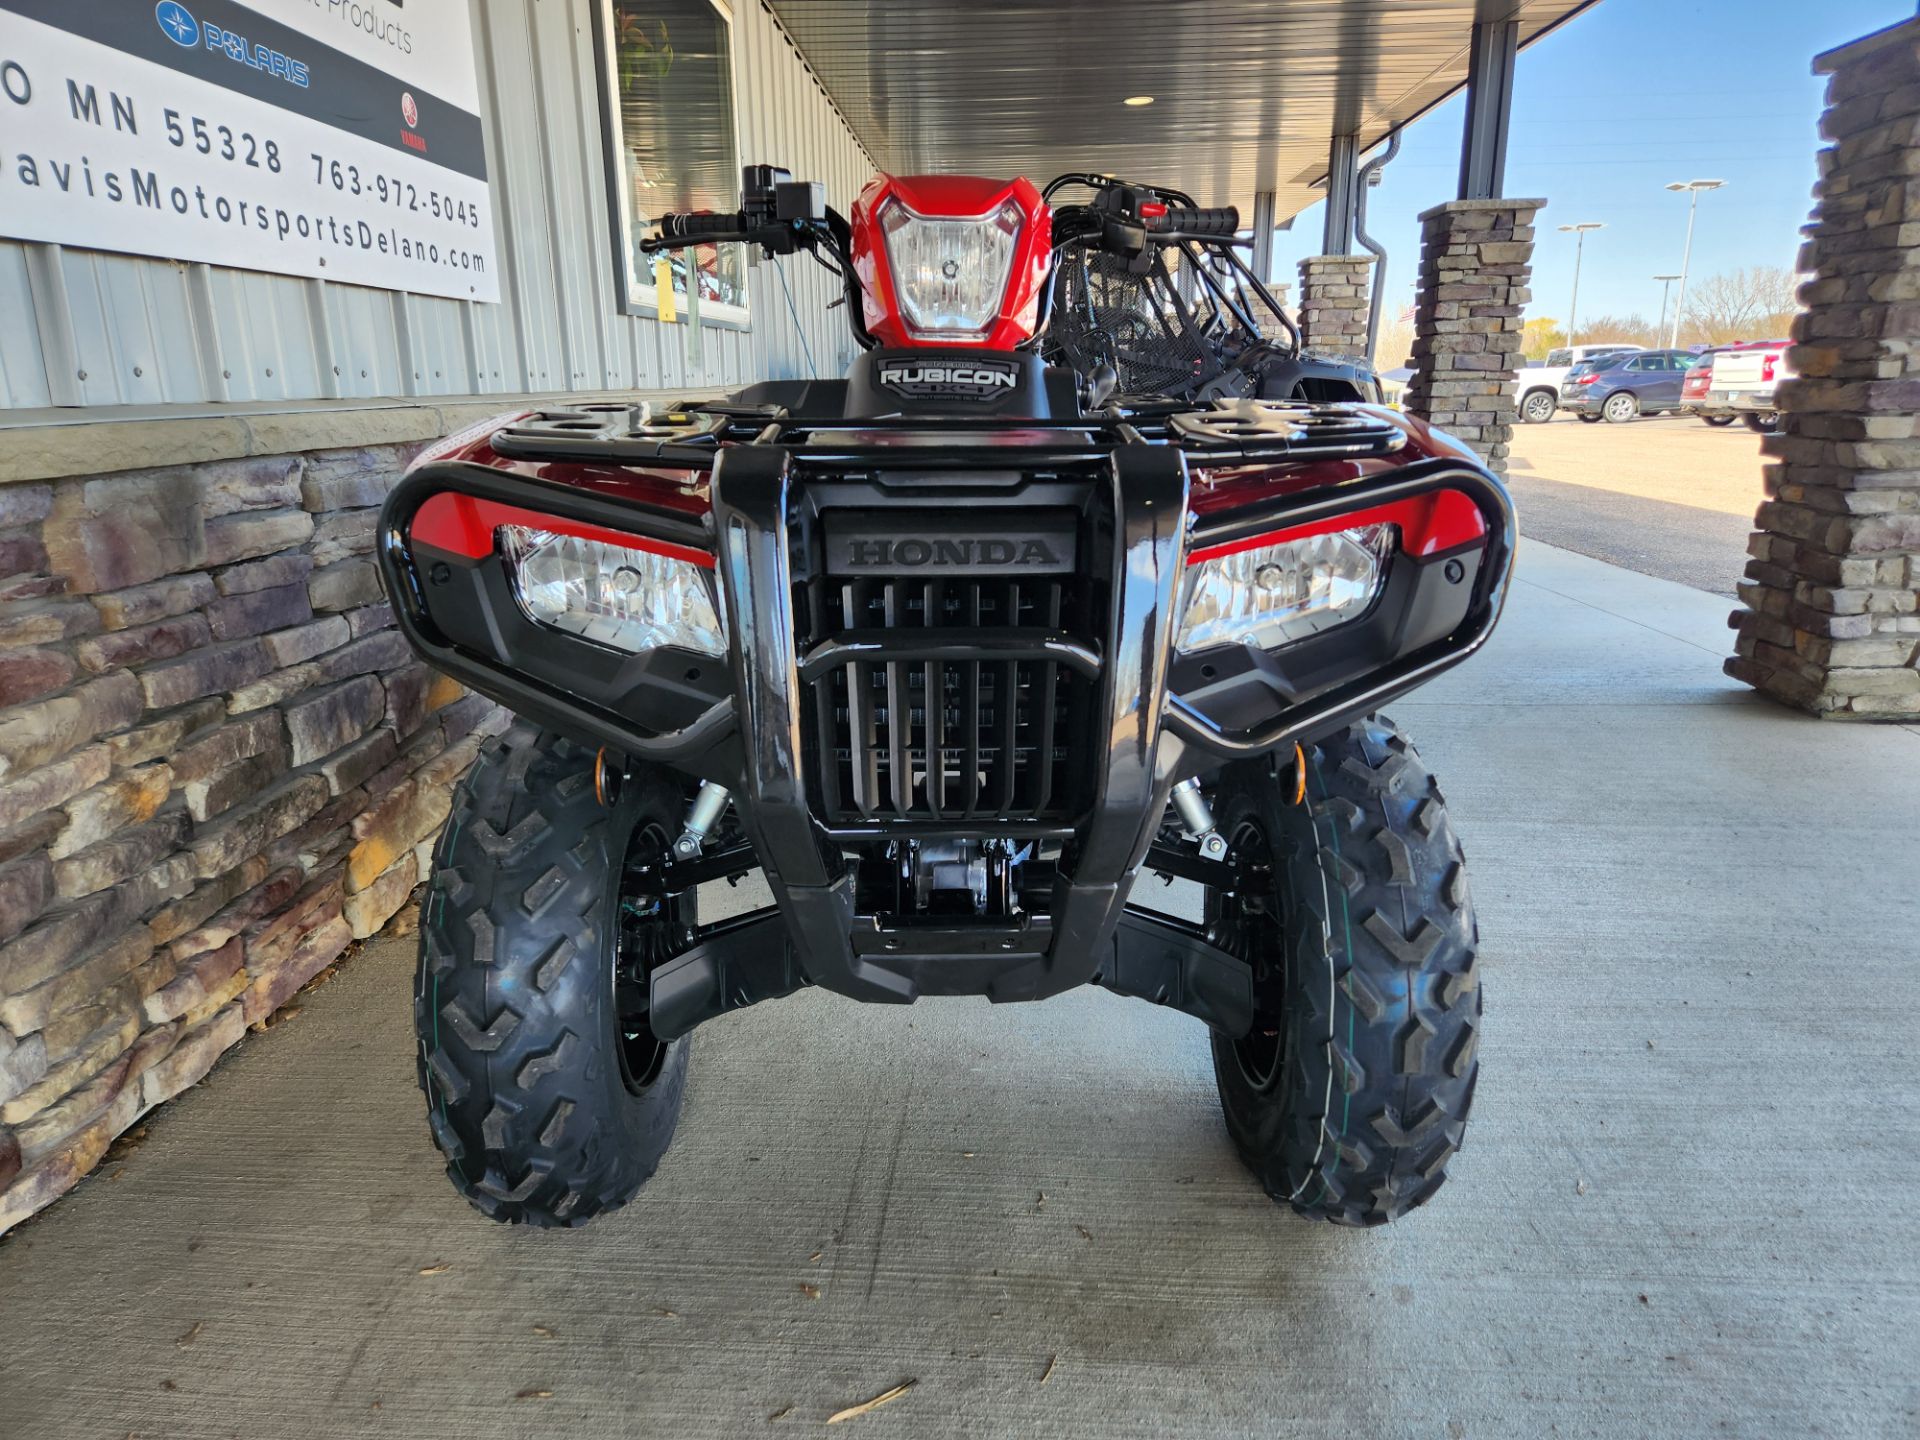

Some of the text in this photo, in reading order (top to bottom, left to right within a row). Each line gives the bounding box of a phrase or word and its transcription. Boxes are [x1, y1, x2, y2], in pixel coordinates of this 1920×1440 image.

[202, 20, 310, 88] POLARIS
[66, 77, 138, 136] MN
[163, 108, 281, 173] 55328
[311, 153, 478, 228] 763-972-5045
[0, 153, 485, 272] avisMotorsportsDelano.com
[880, 368, 1017, 388] RUBICON
[848, 539, 1060, 566] HONDA
